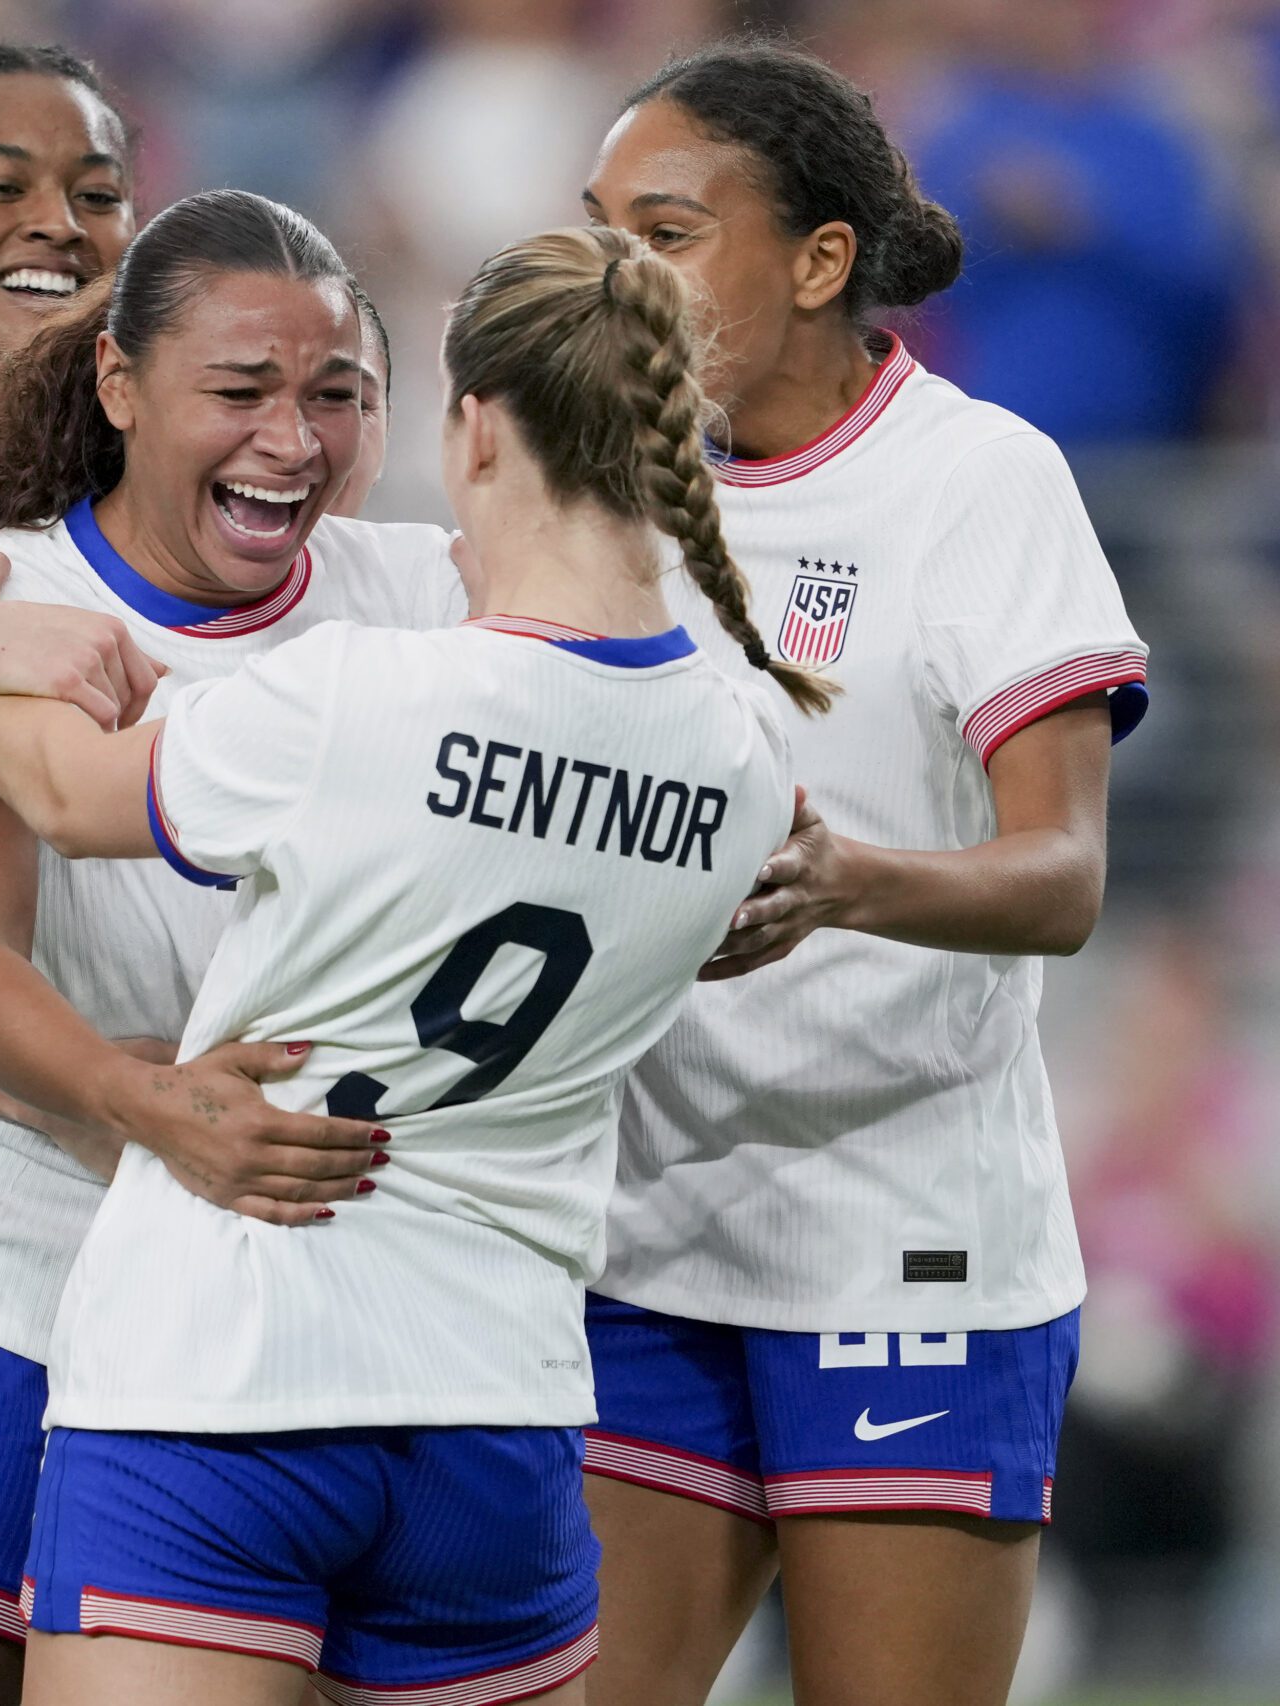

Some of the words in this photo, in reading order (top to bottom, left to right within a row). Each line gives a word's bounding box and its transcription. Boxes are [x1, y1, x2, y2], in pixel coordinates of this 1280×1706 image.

[794, 582, 851, 622] USA
[426, 731, 728, 871] SENTNOR
[325, 901, 593, 1120] 9
